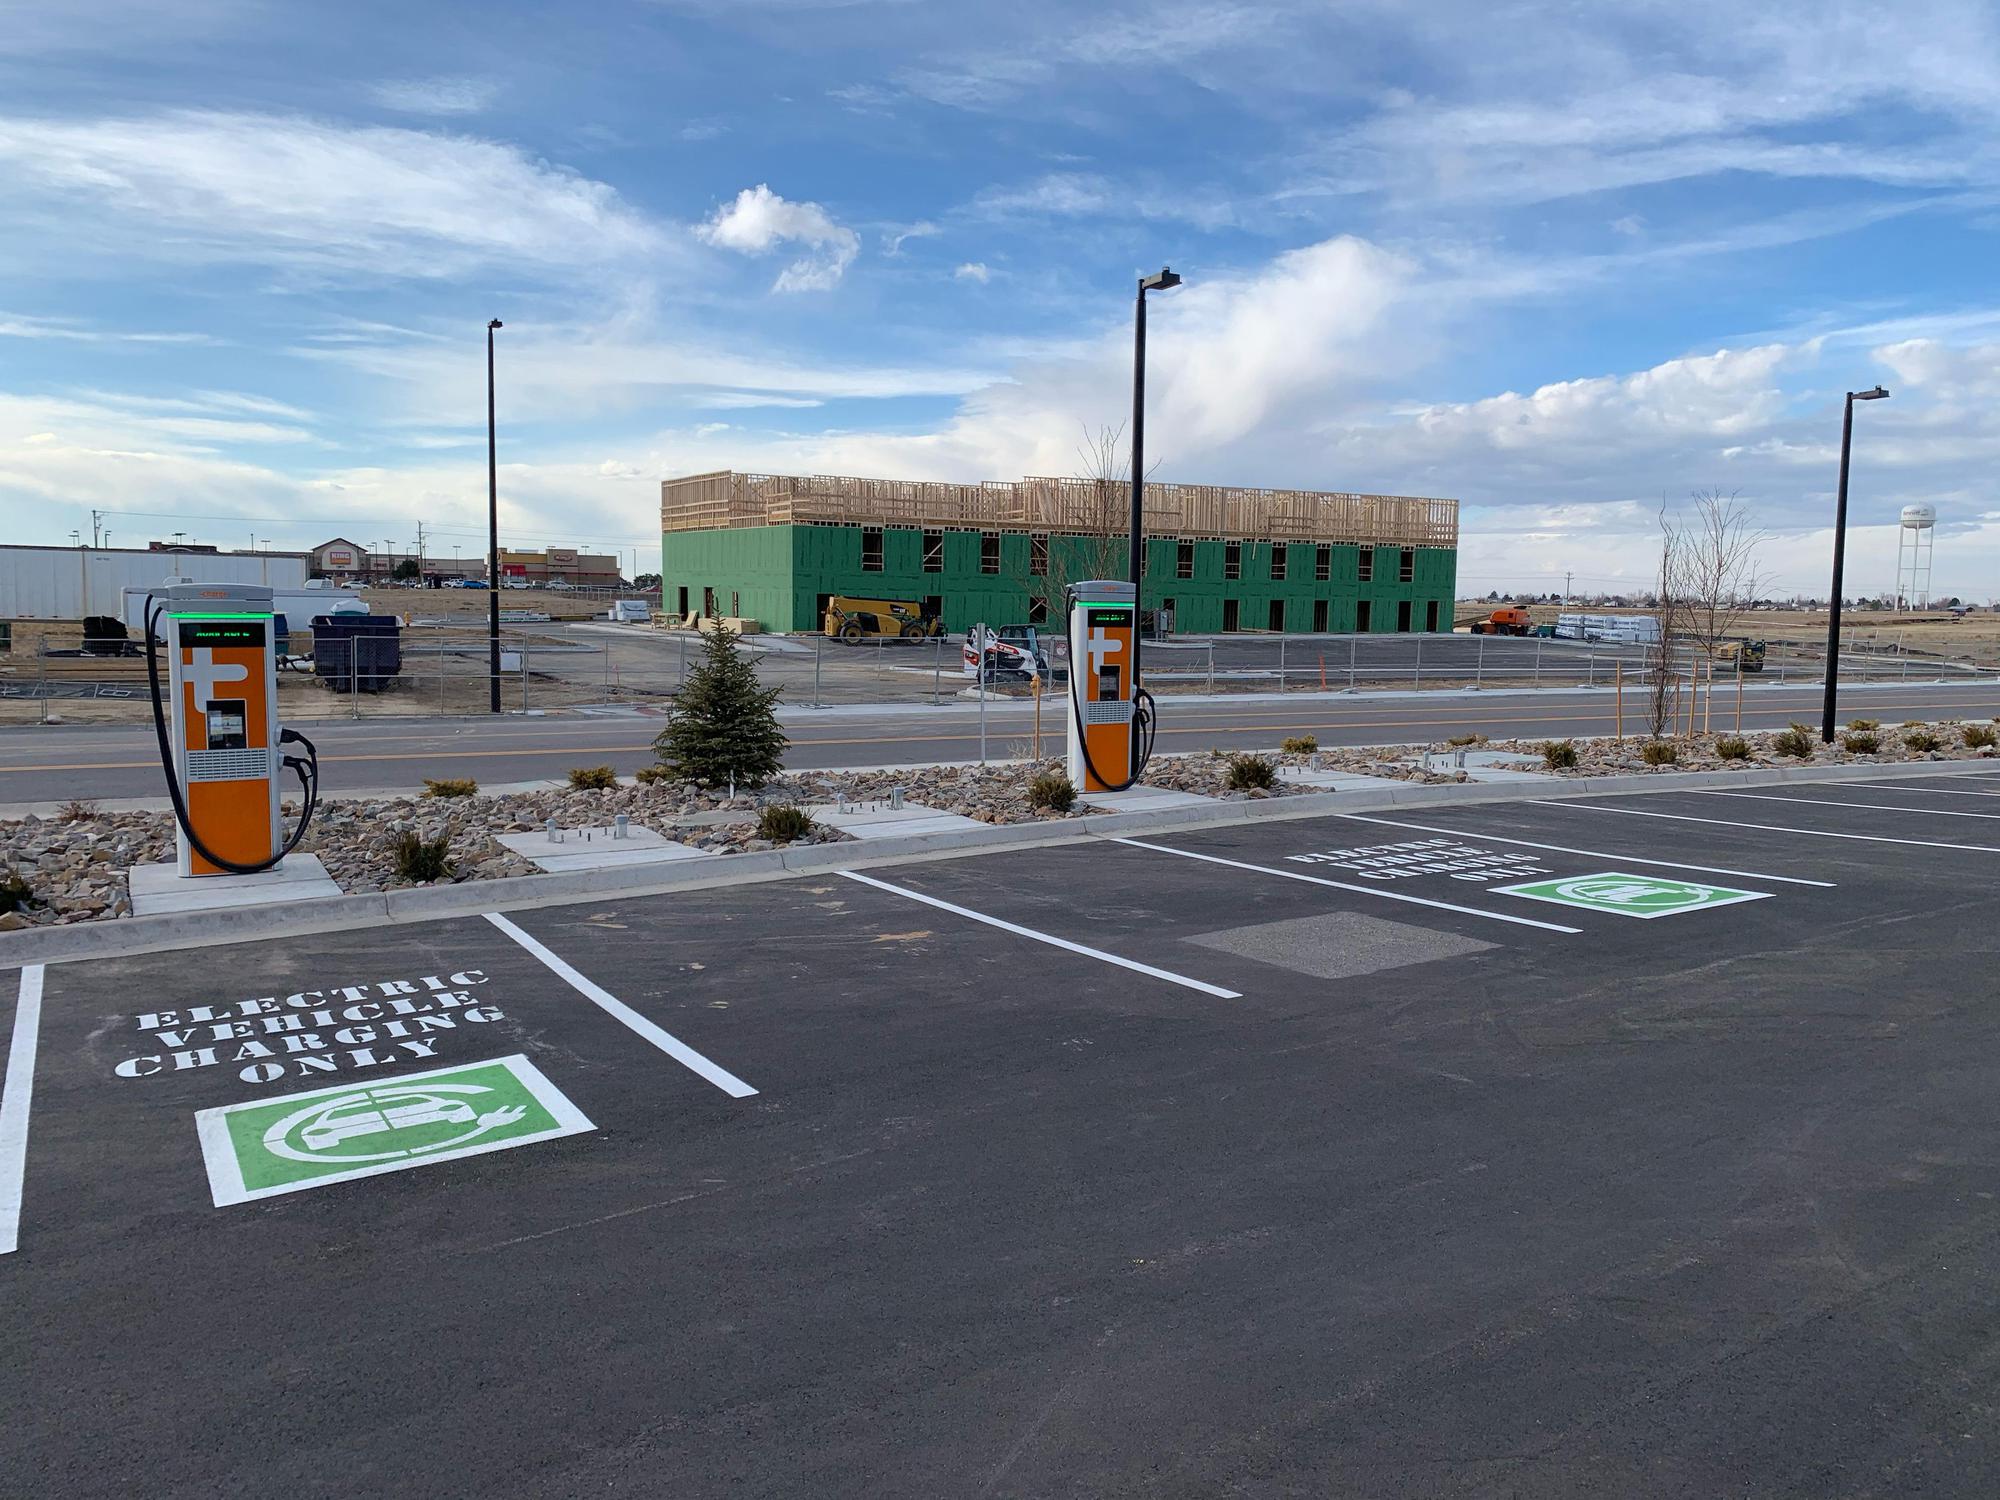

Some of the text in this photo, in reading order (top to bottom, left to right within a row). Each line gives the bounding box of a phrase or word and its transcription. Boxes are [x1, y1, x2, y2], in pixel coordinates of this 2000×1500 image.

[1284, 838, 1463, 863] ELECTRIC
[1328, 846, 1494, 870] VEHICLE
[1357, 853, 1541, 880] CHARGING
[1449, 864, 1554, 882] ONLY
[136, 970, 489, 1030] ELECTRIC
[155, 990, 479, 1047] VEHICLE
[114, 1006, 503, 1077] CHARGING
[239, 1037, 438, 1083] ONLY
